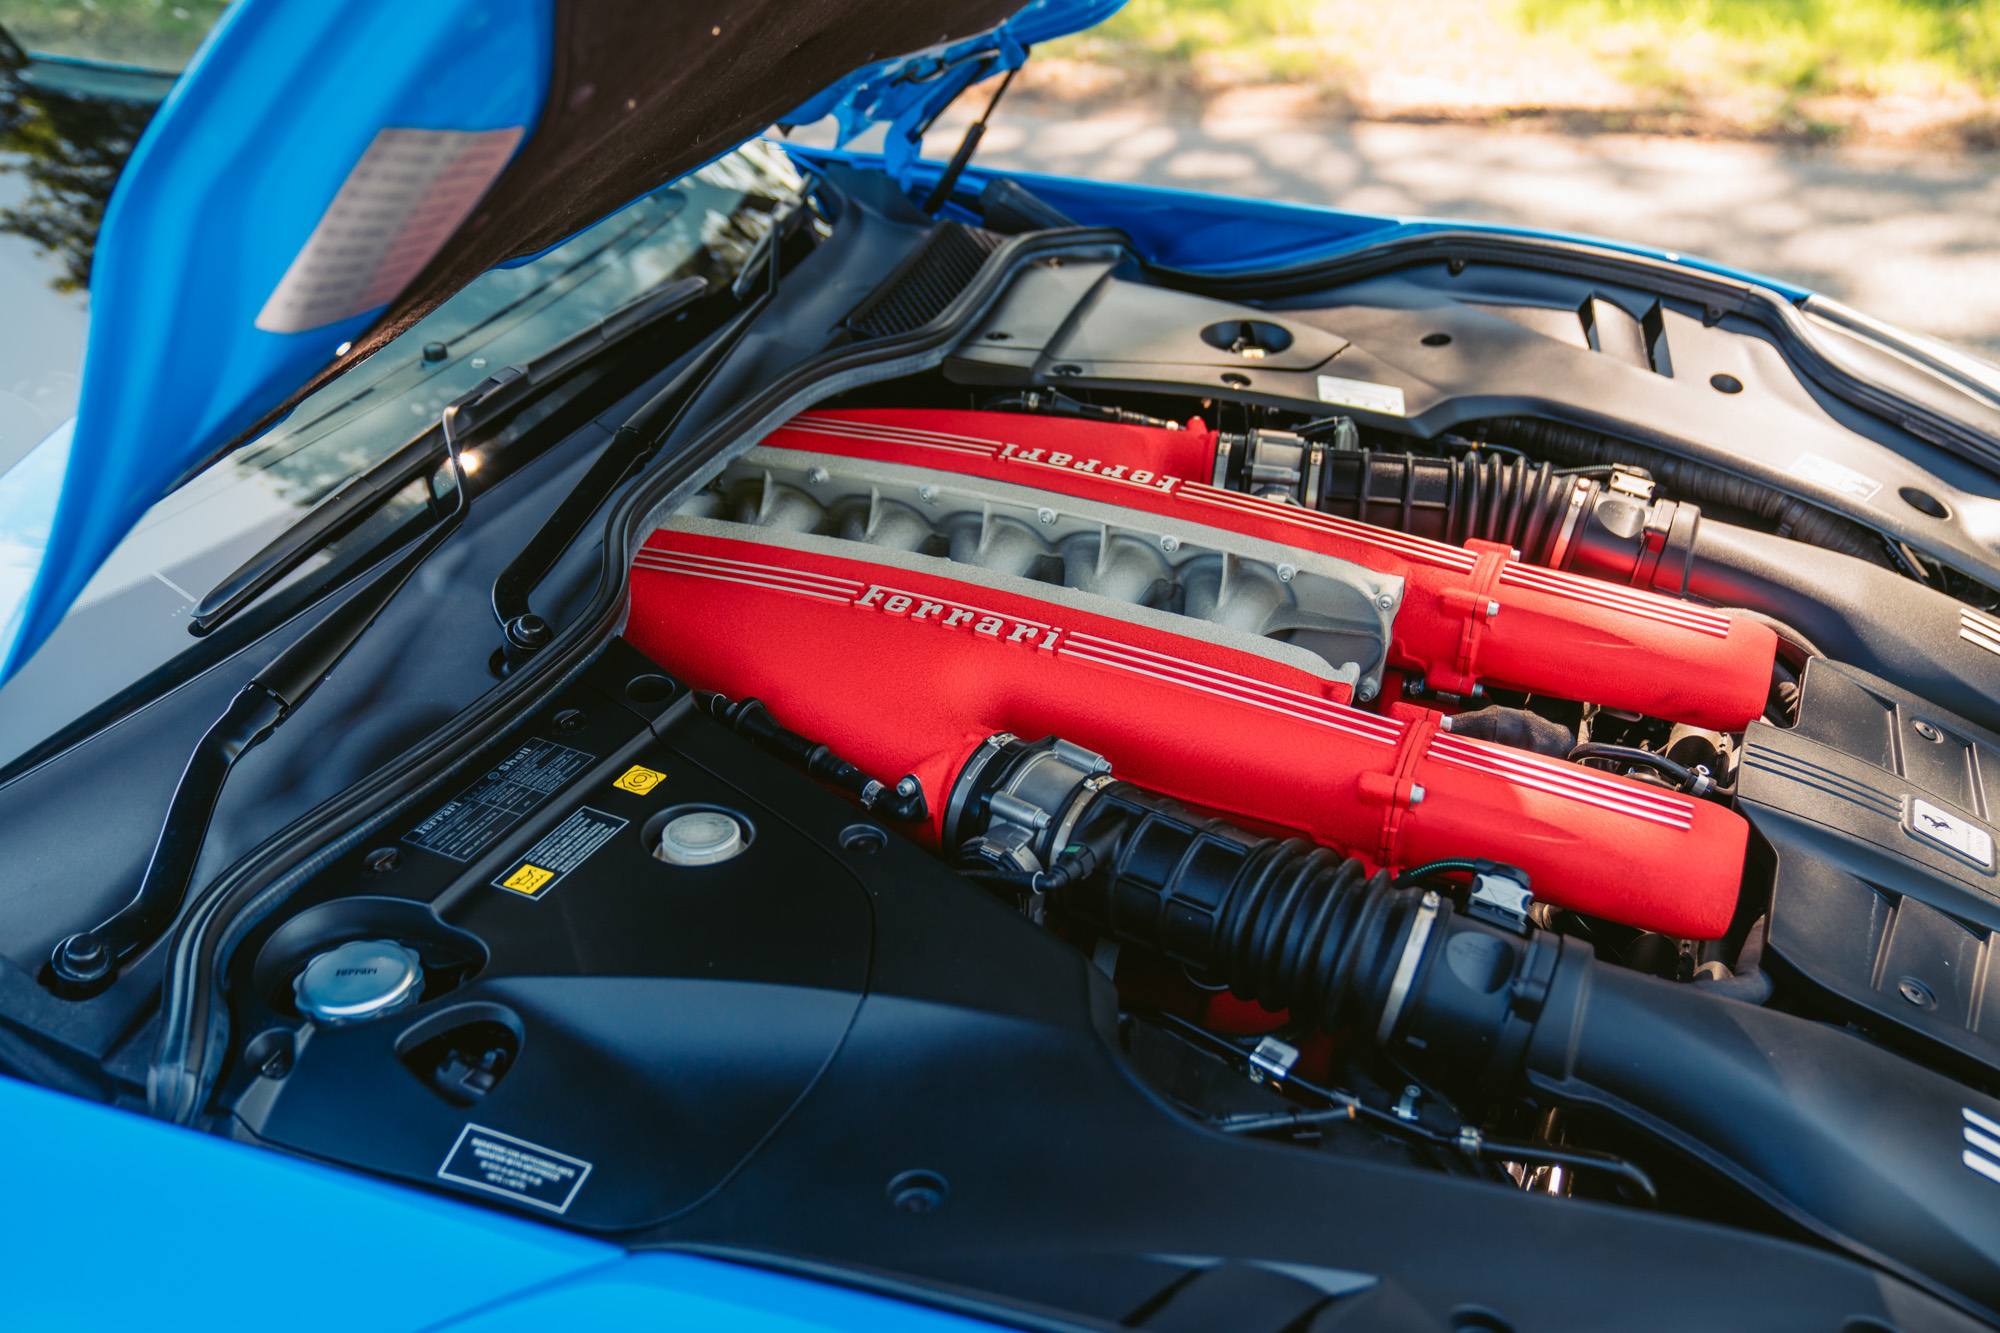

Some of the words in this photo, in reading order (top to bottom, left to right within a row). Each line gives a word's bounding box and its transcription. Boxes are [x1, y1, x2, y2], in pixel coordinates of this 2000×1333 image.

[1000, 443, 1181, 493] Ferrari
[855, 584, 1062, 650] Ferrari
[498, 747, 532, 772] Shell
[414, 800, 462, 835] Ferrari
